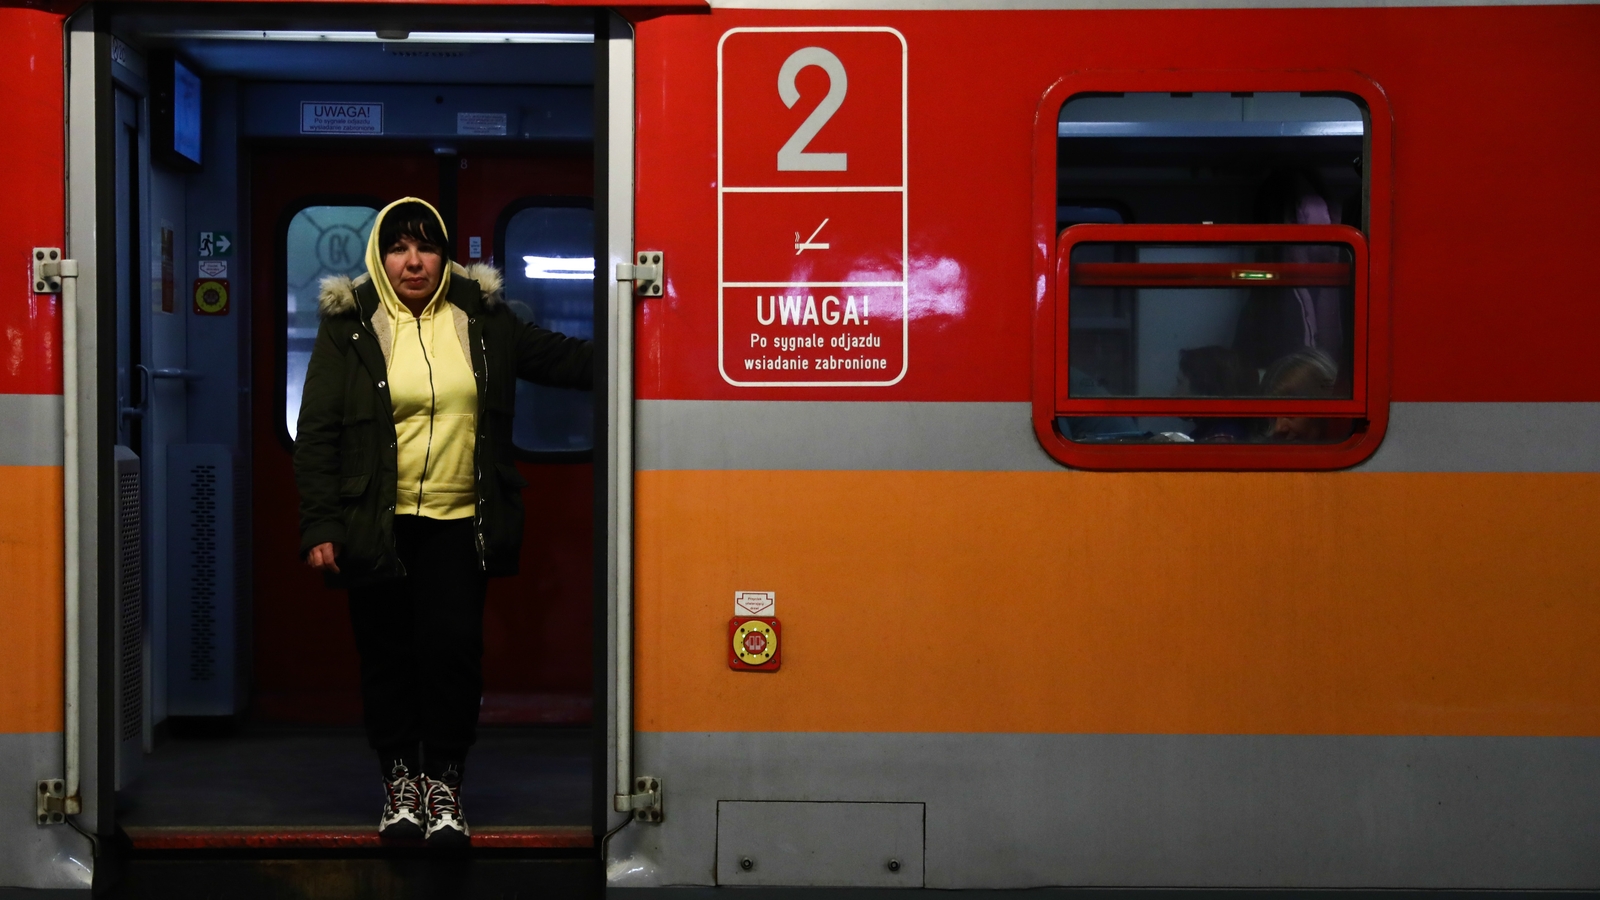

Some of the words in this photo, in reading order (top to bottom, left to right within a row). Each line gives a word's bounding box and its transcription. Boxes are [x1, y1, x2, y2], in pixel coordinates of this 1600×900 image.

[314, 106, 370, 118] UWAGA!
[777, 46, 848, 171] 2
[460, 158, 468, 169] 8
[757, 295, 869, 325] UWAGA!
[750, 333, 767, 348] Po
[773, 333, 824, 352] sygnale
[830, 332, 881, 351] odjazdu
[744, 355, 809, 370] wsiadanie
[815, 355, 887, 370] zabronione
